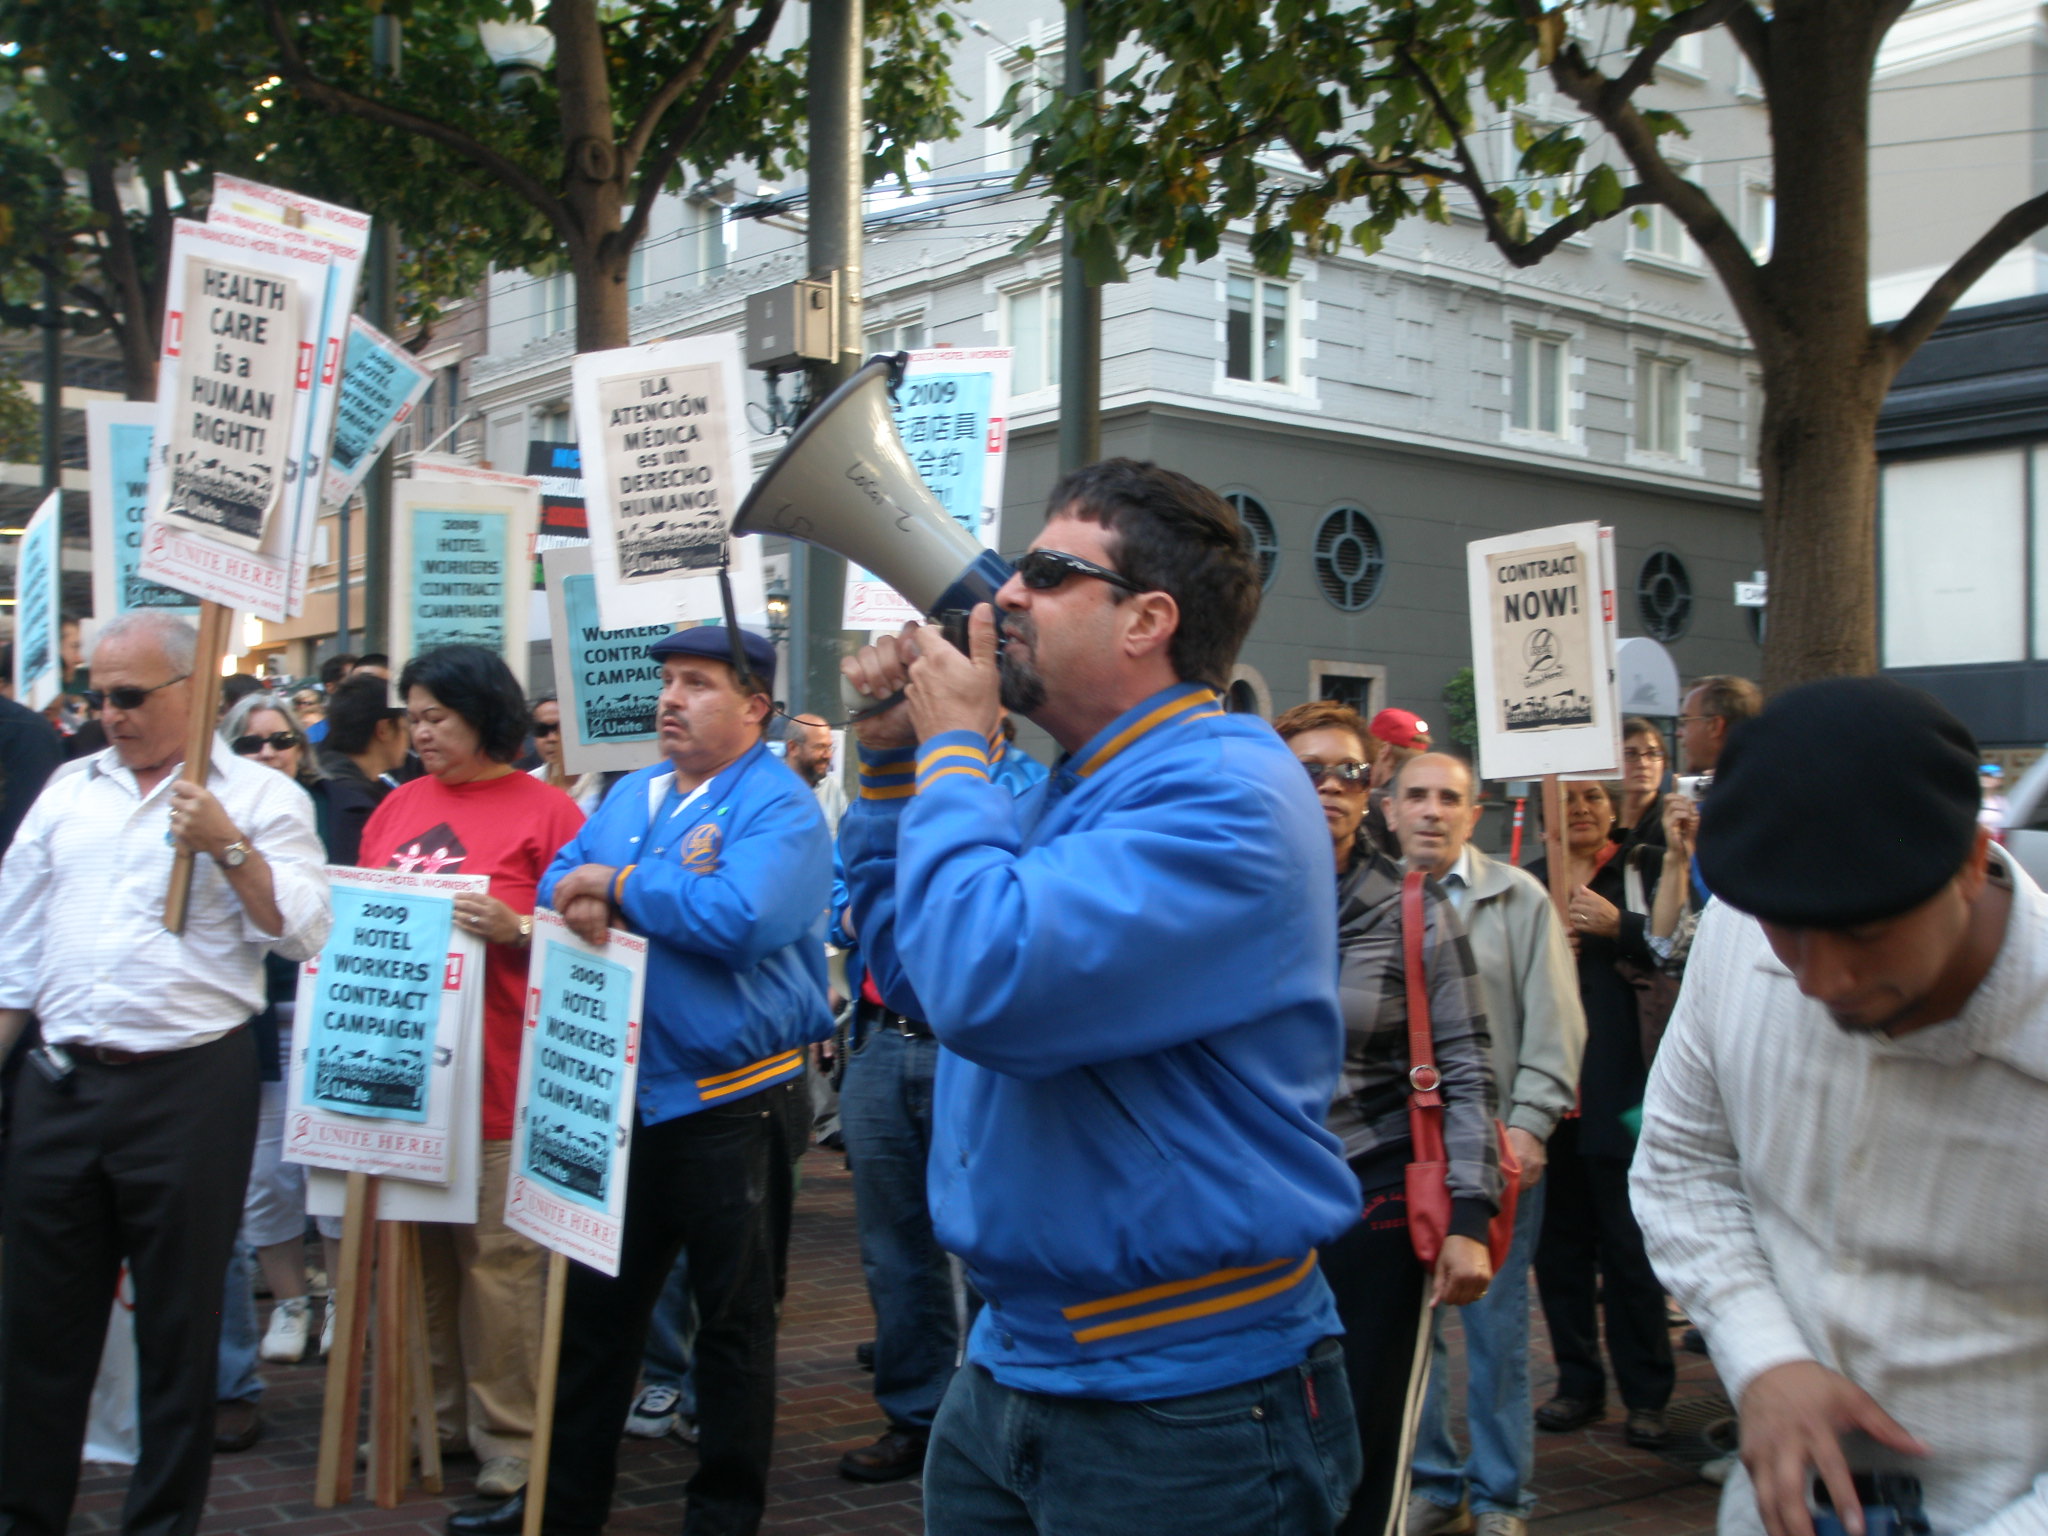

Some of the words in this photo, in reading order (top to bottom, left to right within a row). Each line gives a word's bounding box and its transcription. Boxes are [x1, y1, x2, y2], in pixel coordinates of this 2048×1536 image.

[203, 268, 287, 311] HEALTH
[210, 308, 269, 345] CARE
[213, 343, 231, 372] is
[237, 357, 251, 378] a
[192, 375, 275, 420] HUMAN
[341, 389, 385, 421] NTRACT
[908, 381, 957, 406] 2009
[609, 394, 708, 428] ATENCIÓN
[192, 412, 267, 455] RIGHT!
[623, 424, 701, 451] MÉDICA
[637, 453, 659, 468] es
[664, 449, 689, 465] un
[619, 465, 712, 494] DERECHO
[619, 488, 718, 519] HUMANO!
[437, 538, 486, 553] HOTEL
[173, 540, 222, 570] UNITE
[225, 560, 284, 590] HERE!
[421, 560, 500, 574] WORKERS
[1497, 555, 1577, 584] CONTRACT
[419, 582, 500, 596] CONTRACT
[418, 604, 503, 618] CAMPAIGN
[1504, 585, 1578, 623] NOW!
[584, 646, 650, 664] CONTRA
[585, 666, 663, 686] CAMPAIG
[605, 721, 643, 734] Unite
[386, 875, 419, 887] HOTEL
[423, 879, 473, 892] WORKERS
[362, 903, 409, 925] 2009
[353, 927, 413, 951] HOTEL
[334, 954, 431, 982] WORKERS
[570, 964, 606, 992] 2009
[328, 983, 429, 1011] CONTRACT
[561, 989, 607, 1022] HOTEL
[323, 1011, 427, 1041] CAMPAIGN
[546, 1015, 617, 1059] WORKERS
[541, 1047, 615, 1089] CONTRACT
[537, 1077, 613, 1123] CAMPAIGN
[319, 1126, 373, 1148] UNITE
[377, 1134, 442, 1156] HERE!
[528, 1193, 568, 1225] UNITE
[570, 1212, 617, 1246] HERE!
